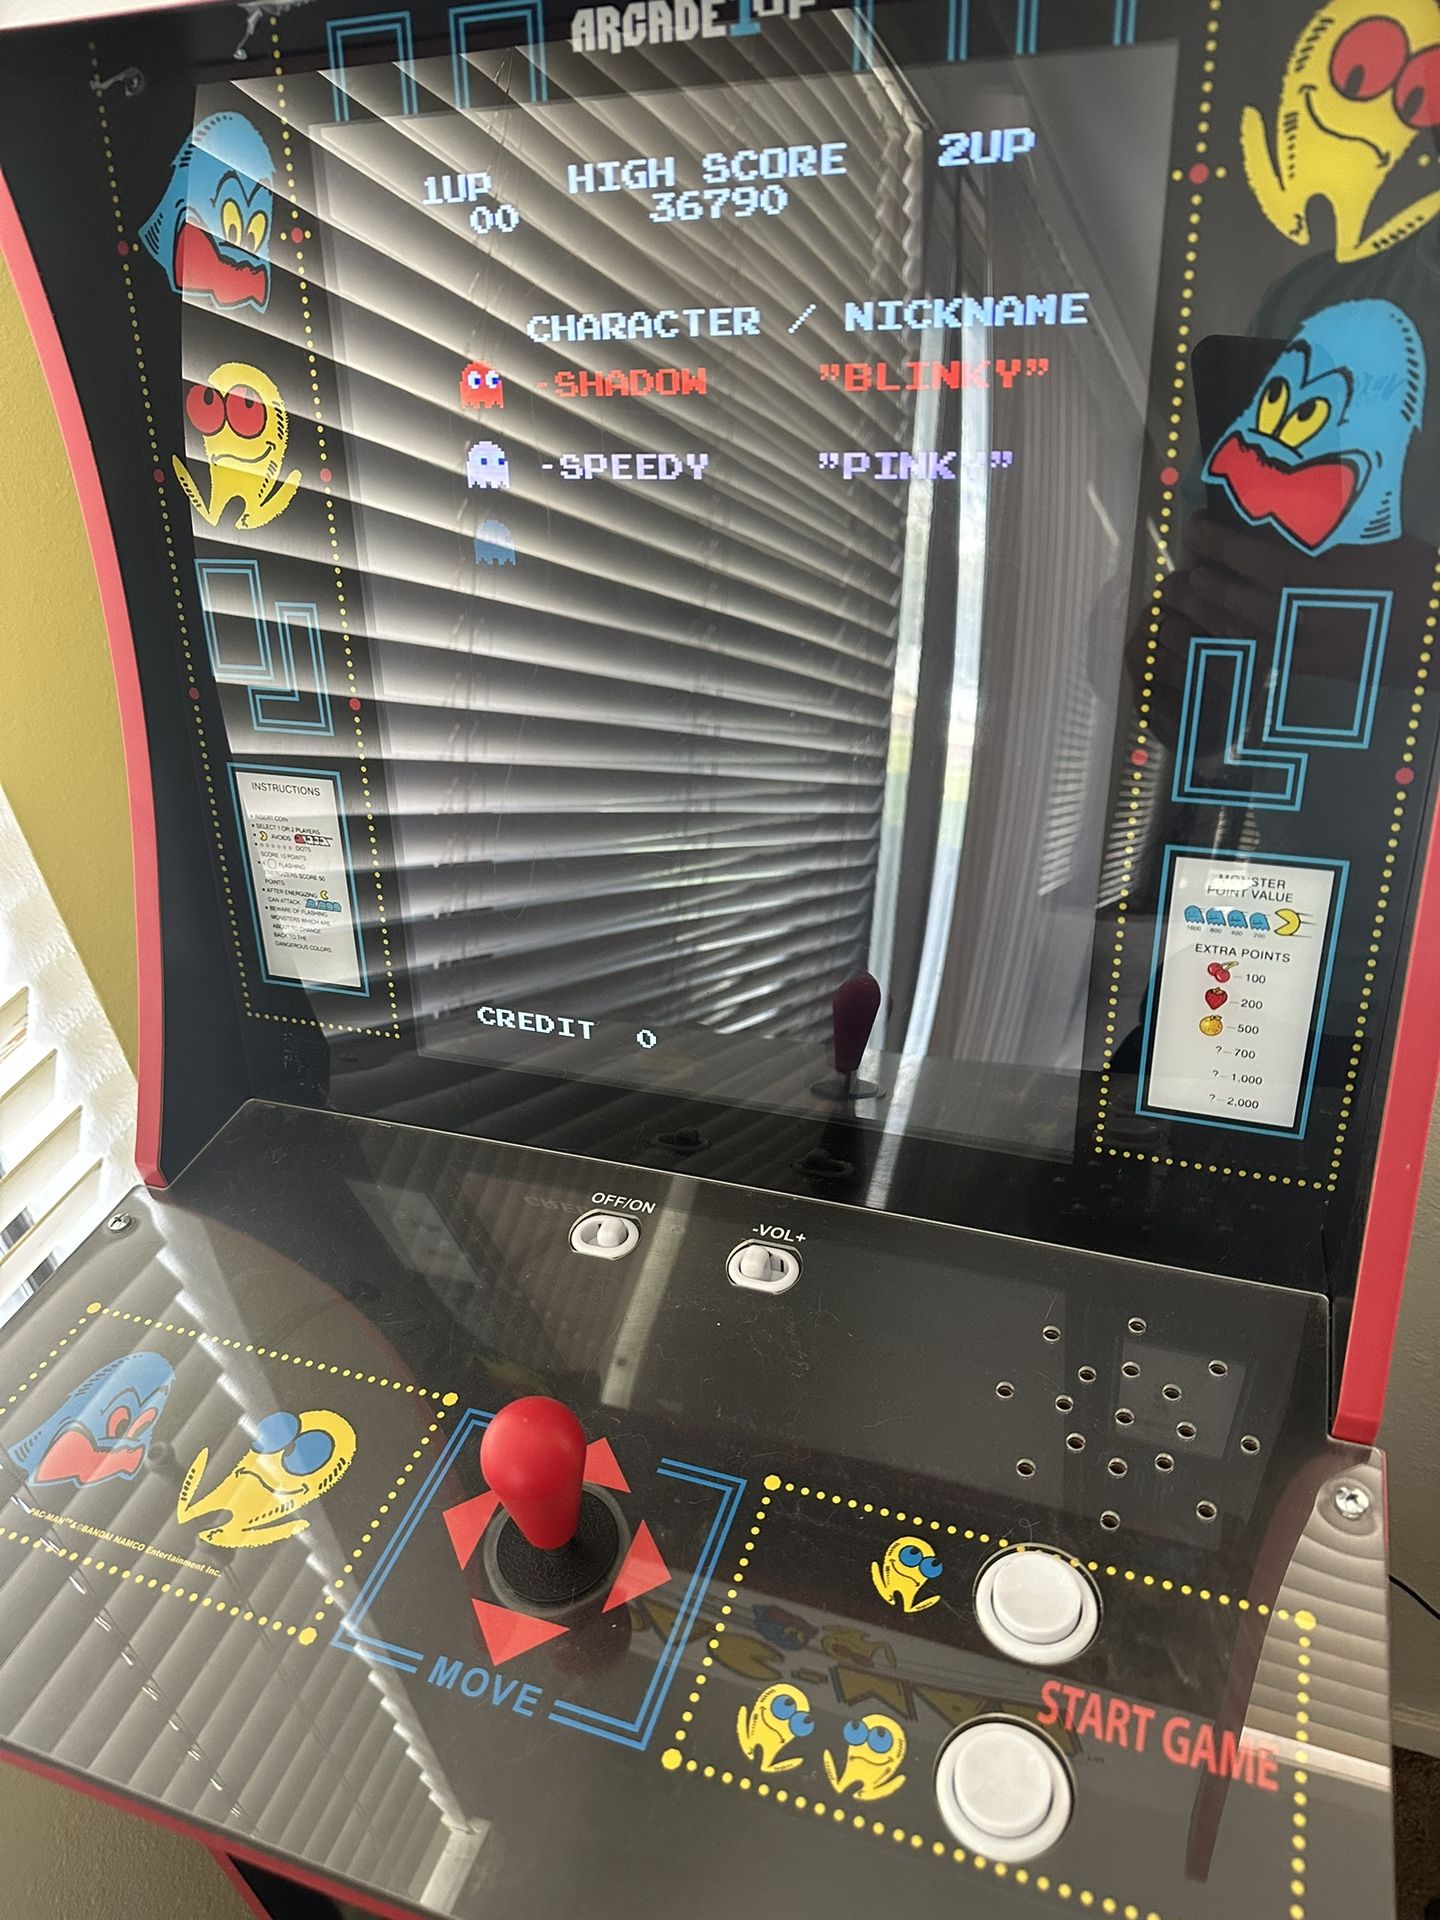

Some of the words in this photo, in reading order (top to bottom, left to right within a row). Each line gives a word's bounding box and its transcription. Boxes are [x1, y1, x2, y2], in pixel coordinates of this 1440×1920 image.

[938, 127, 1036, 167] 2UP
[567, 156, 676, 194] HIGH
[702, 142, 848, 184] SCORE
[423, 172, 492, 206] 1UP
[649, 184, 789, 223] 36790
[469, 204, 519, 234] 00
[526, 306, 761, 342] CHARACTER
[787, 303, 817, 334] /
[845, 292, 1090, 333] NICKNAME
[535, 367, 708, 398] -SHADOW
[541, 453, 709, 480] -SPEEDY
[251, 782, 321, 796] INSTRUCTIONS
[256, 823, 276, 831] SELECT
[1219, 873, 1287, 890] MOSTER
[1251, 889, 1294, 903] VALUE
[1195, 943, 1238, 957] EXTRA
[1241, 948, 1291, 963] POINTS
[476, 1006, 595, 1040] CREDIT
[591, 1192, 656, 1214] OFF/ON
[752, 1223, 807, 1243] -VOL+
[113, 1535, 146, 1552] NAMCO
[144, 1545, 206, 1572] Entertainment
[205, 1566, 222, 1578] Inc.
[427, 1655, 544, 1718] MOVE
[1037, 1679, 1156, 1752] START
[1162, 1716, 1281, 1793] GAME
